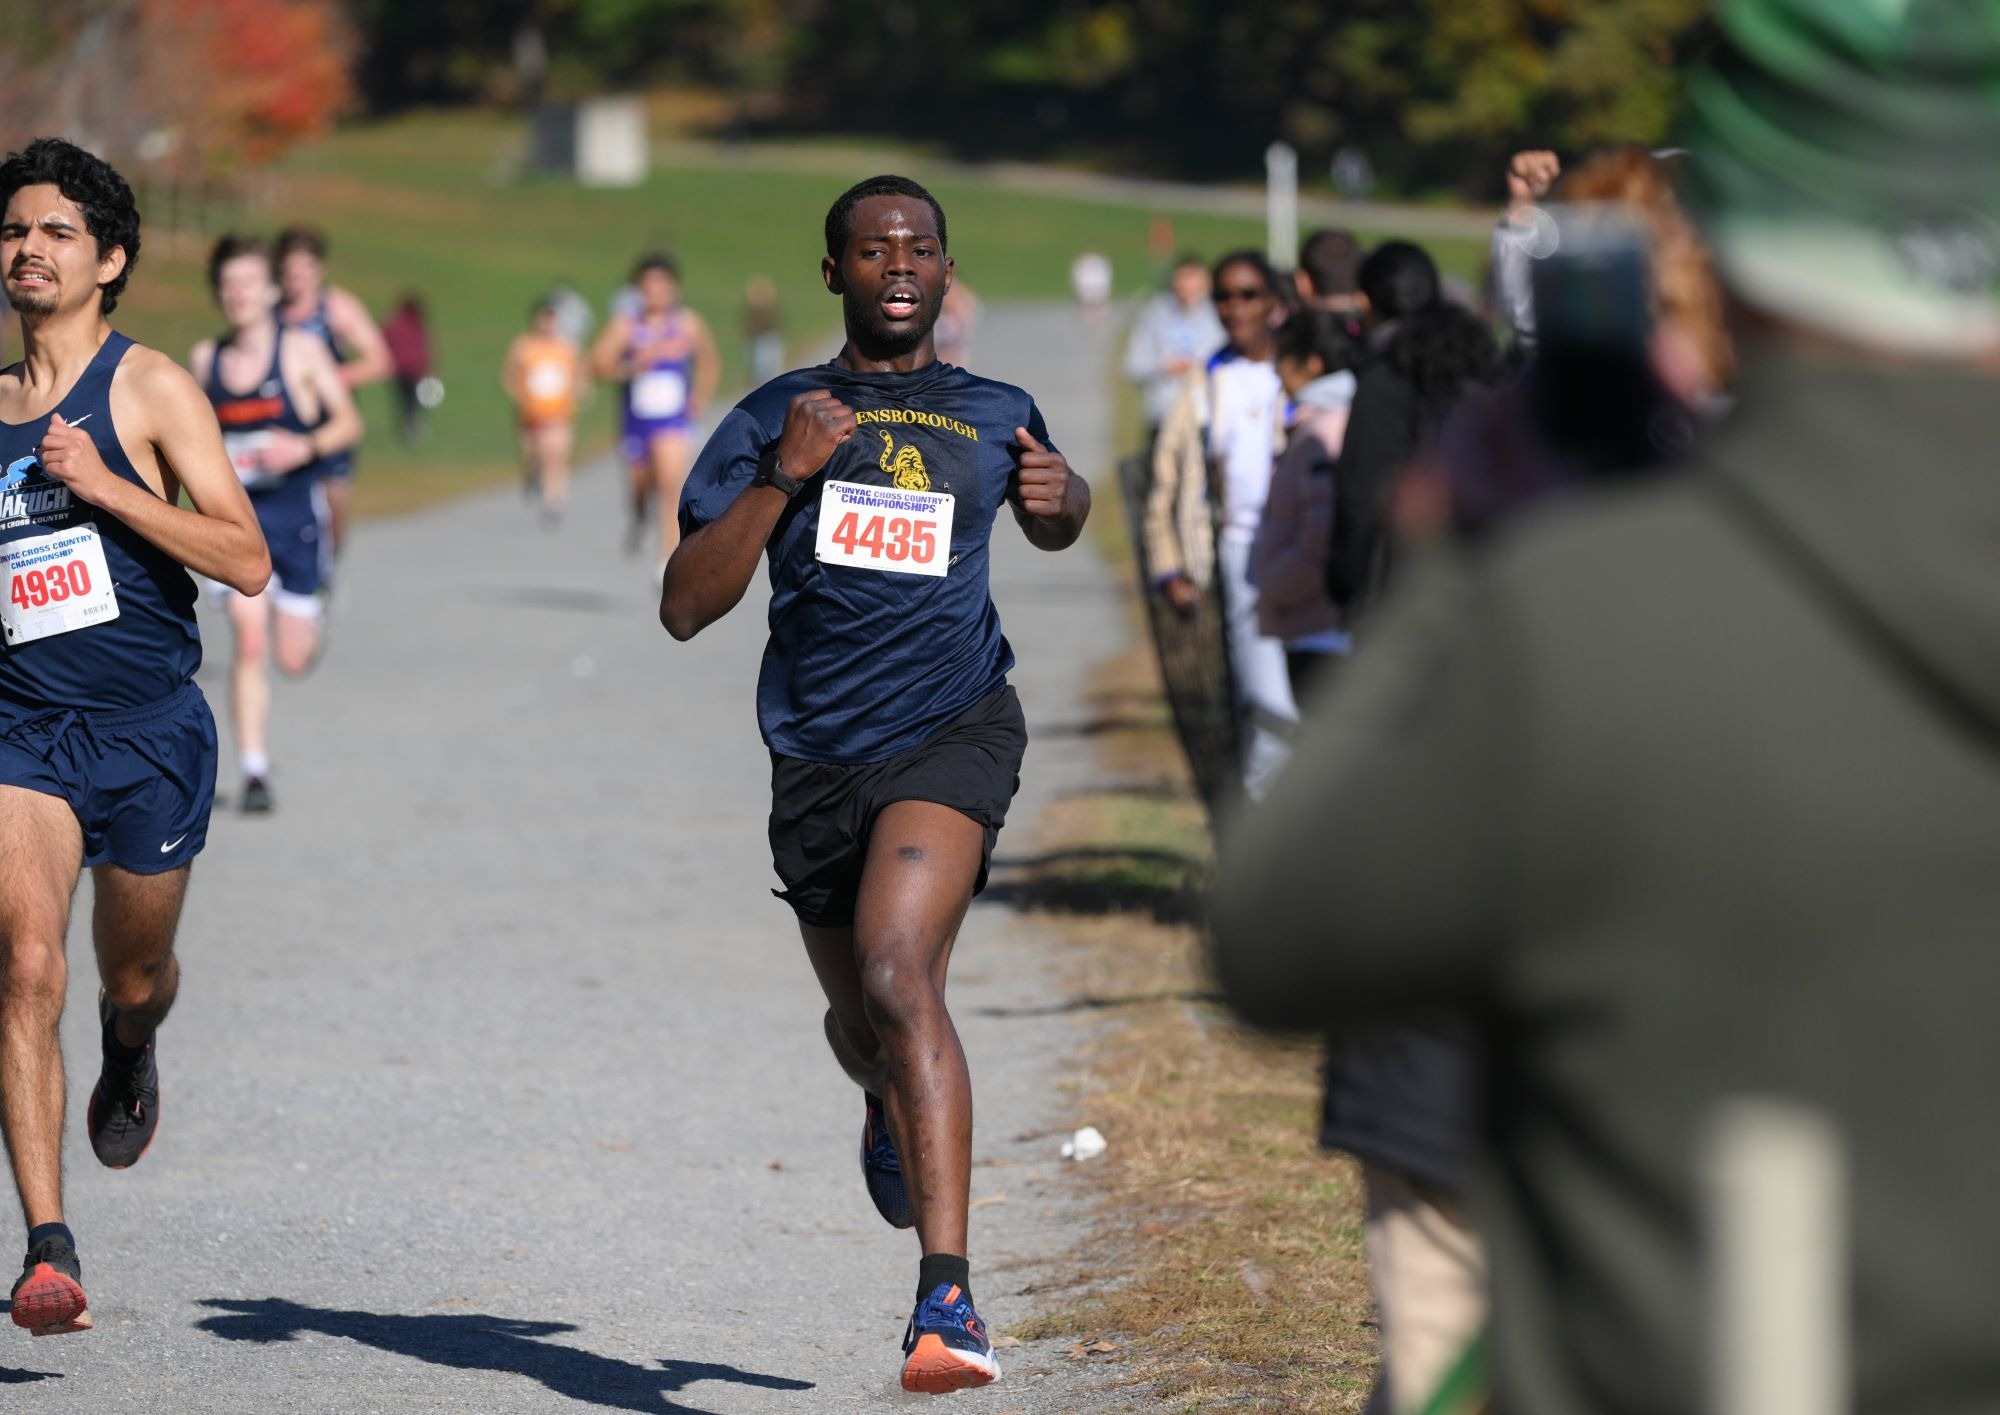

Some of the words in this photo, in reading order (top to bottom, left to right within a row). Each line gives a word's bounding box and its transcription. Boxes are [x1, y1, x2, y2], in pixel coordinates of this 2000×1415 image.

[855, 409, 979, 442] ENSBOROUGH
[835, 485, 872, 498] CUNYAC
[873, 490, 902, 500] CROSS
[904, 494, 943, 505] COUNTRY
[841, 493, 936, 513] CHAMPIONSHIPS
[32, 512, 70, 524] COUNTRY
[22, 545, 50, 557] CROSS
[52, 534, 92, 550] COUNTRY
[832, 511, 937, 564] 4435
[11, 548, 74, 569] CHAMPIONSHIP
[11, 559, 92, 610] 4930
